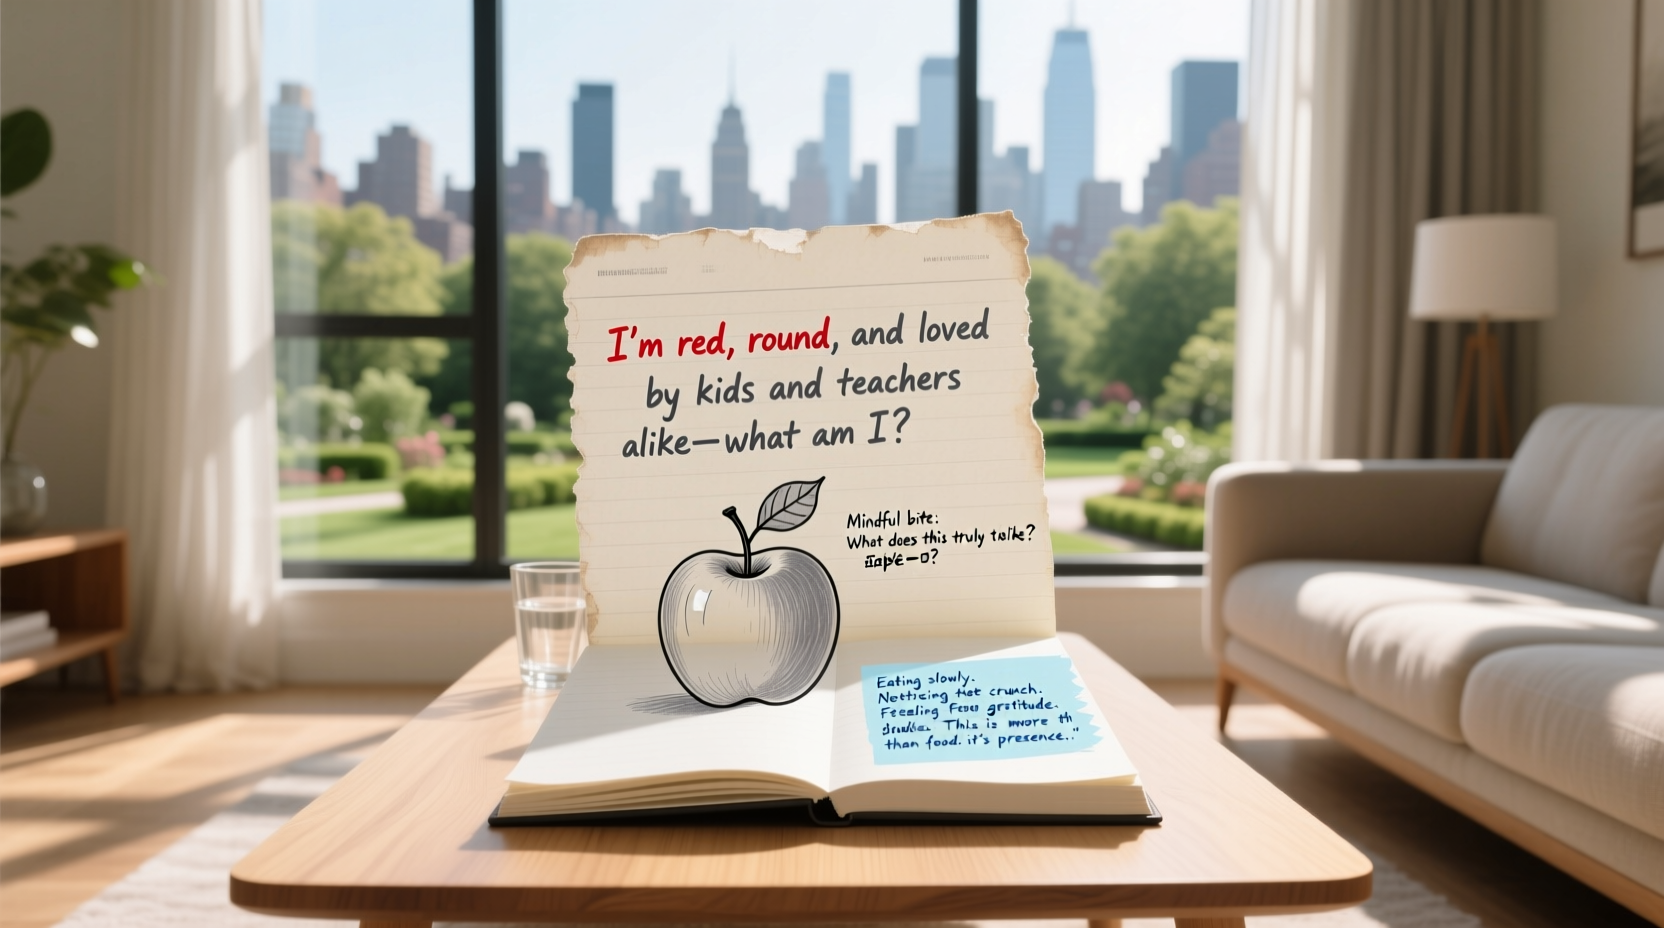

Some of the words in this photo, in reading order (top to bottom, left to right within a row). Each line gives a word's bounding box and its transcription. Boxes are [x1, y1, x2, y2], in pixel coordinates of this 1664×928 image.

[607, 325, 663, 362] I'm
[677, 321, 735, 361] red,
[748, 315, 839, 355] round,
[851, 312, 904, 346] and
[919, 307, 990, 343] loved
[646, 375, 680, 422] by
[696, 371, 755, 405] kids
[769, 366, 823, 400] and
[836, 362, 962, 396] teachers
[812, 425, 854, 447] am
[867, 406, 911, 444] I?
[847, 510, 900, 529] Mindful
[907, 509, 939, 526] bite:
[847, 534, 884, 549] What
[888, 532, 918, 547] does
[922, 530, 947, 544] this
[952, 528, 985, 548] truly
[877, 675, 922, 690] Eating
[928, 671, 976, 688] slowly.
[884, 738, 919, 750] than
[925, 734, 962, 750] food.
[967, 733, 990, 746] it's
